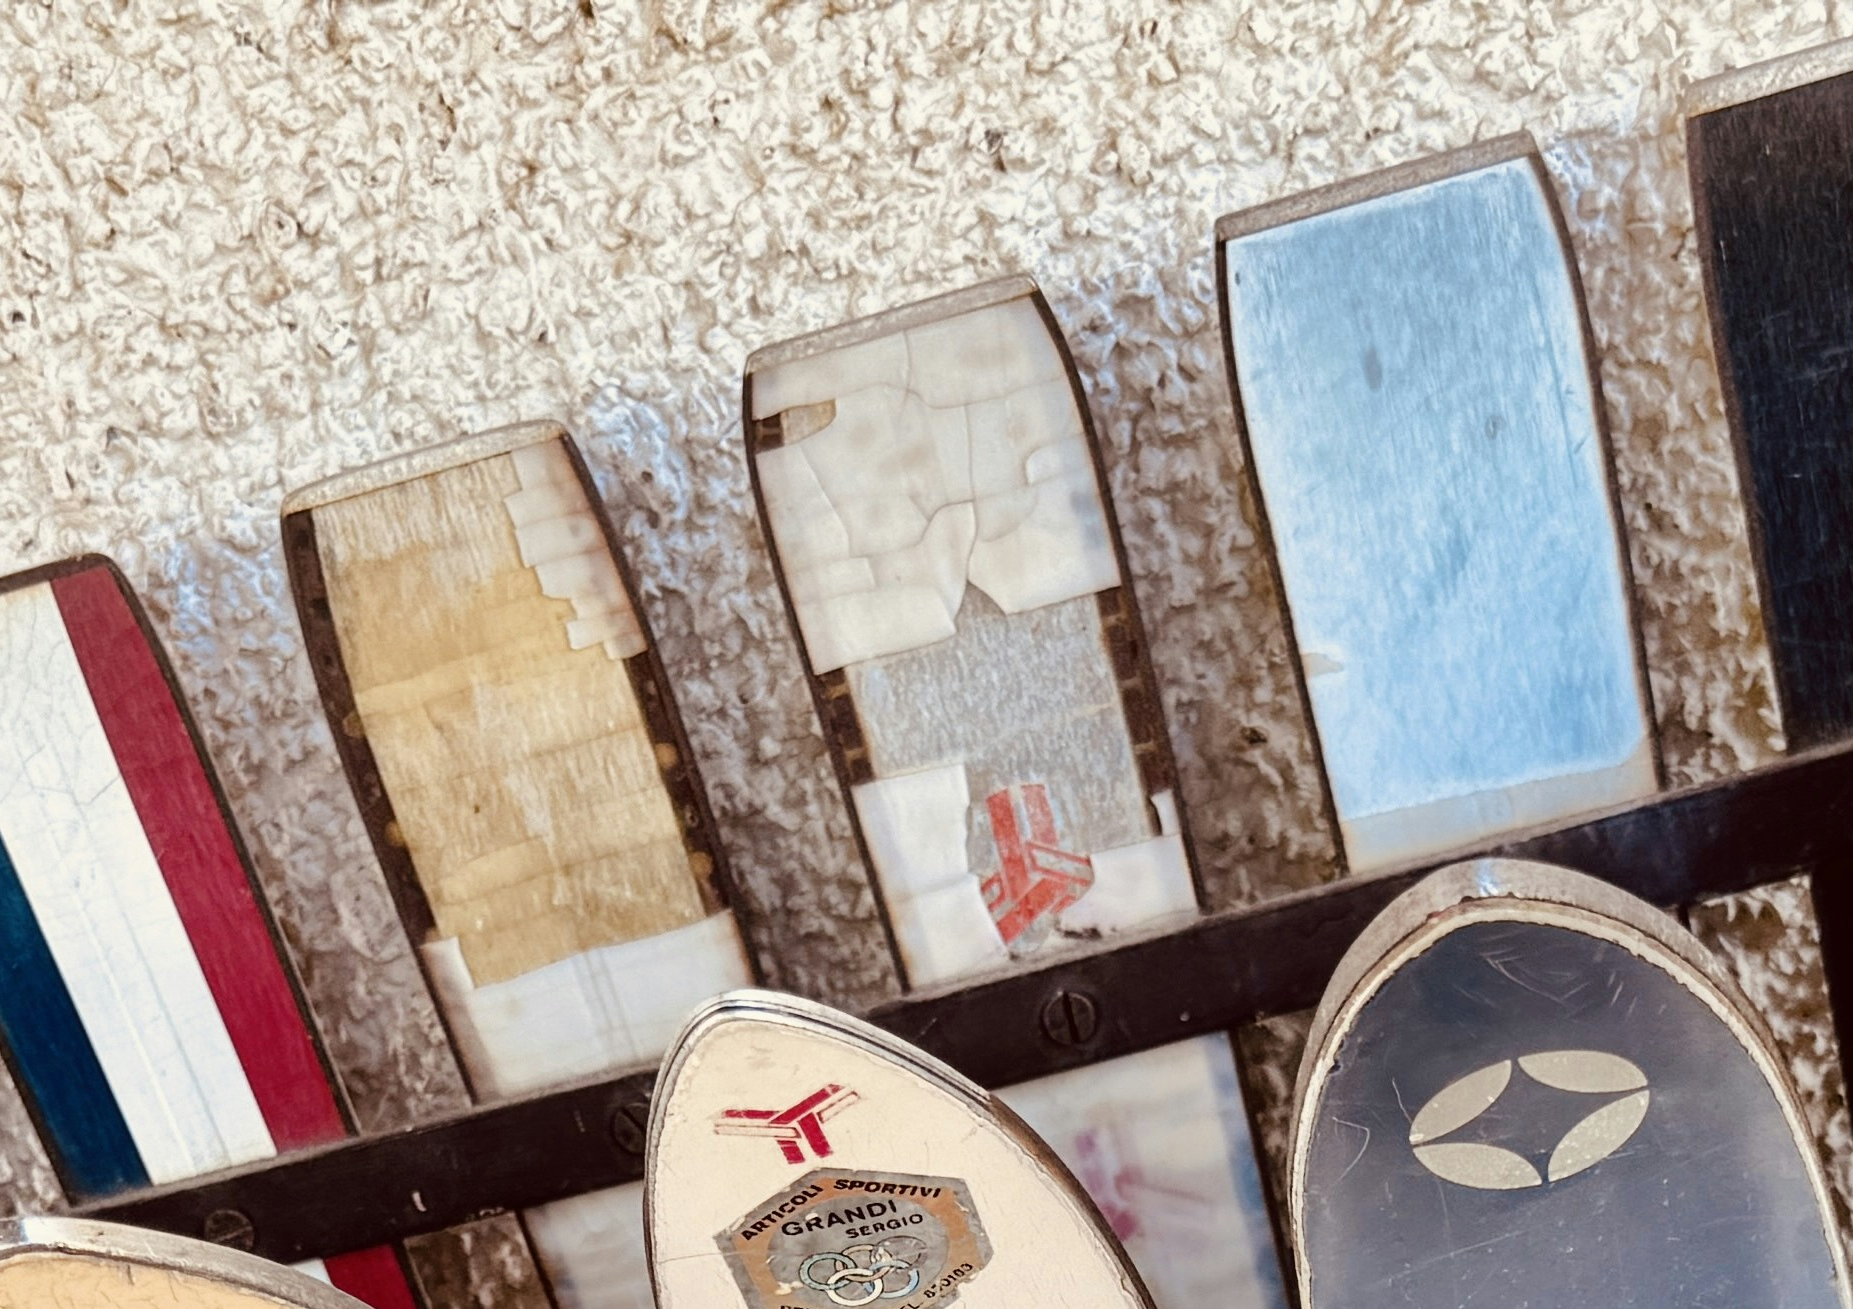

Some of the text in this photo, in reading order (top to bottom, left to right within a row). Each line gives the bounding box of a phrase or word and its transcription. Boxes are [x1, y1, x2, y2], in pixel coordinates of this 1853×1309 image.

[741, 1178, 943, 1242] ARTICOLI SPORTIVI
[781, 1199, 898, 1237] GRANDI
[845, 1213, 924, 1240] SERGIO
